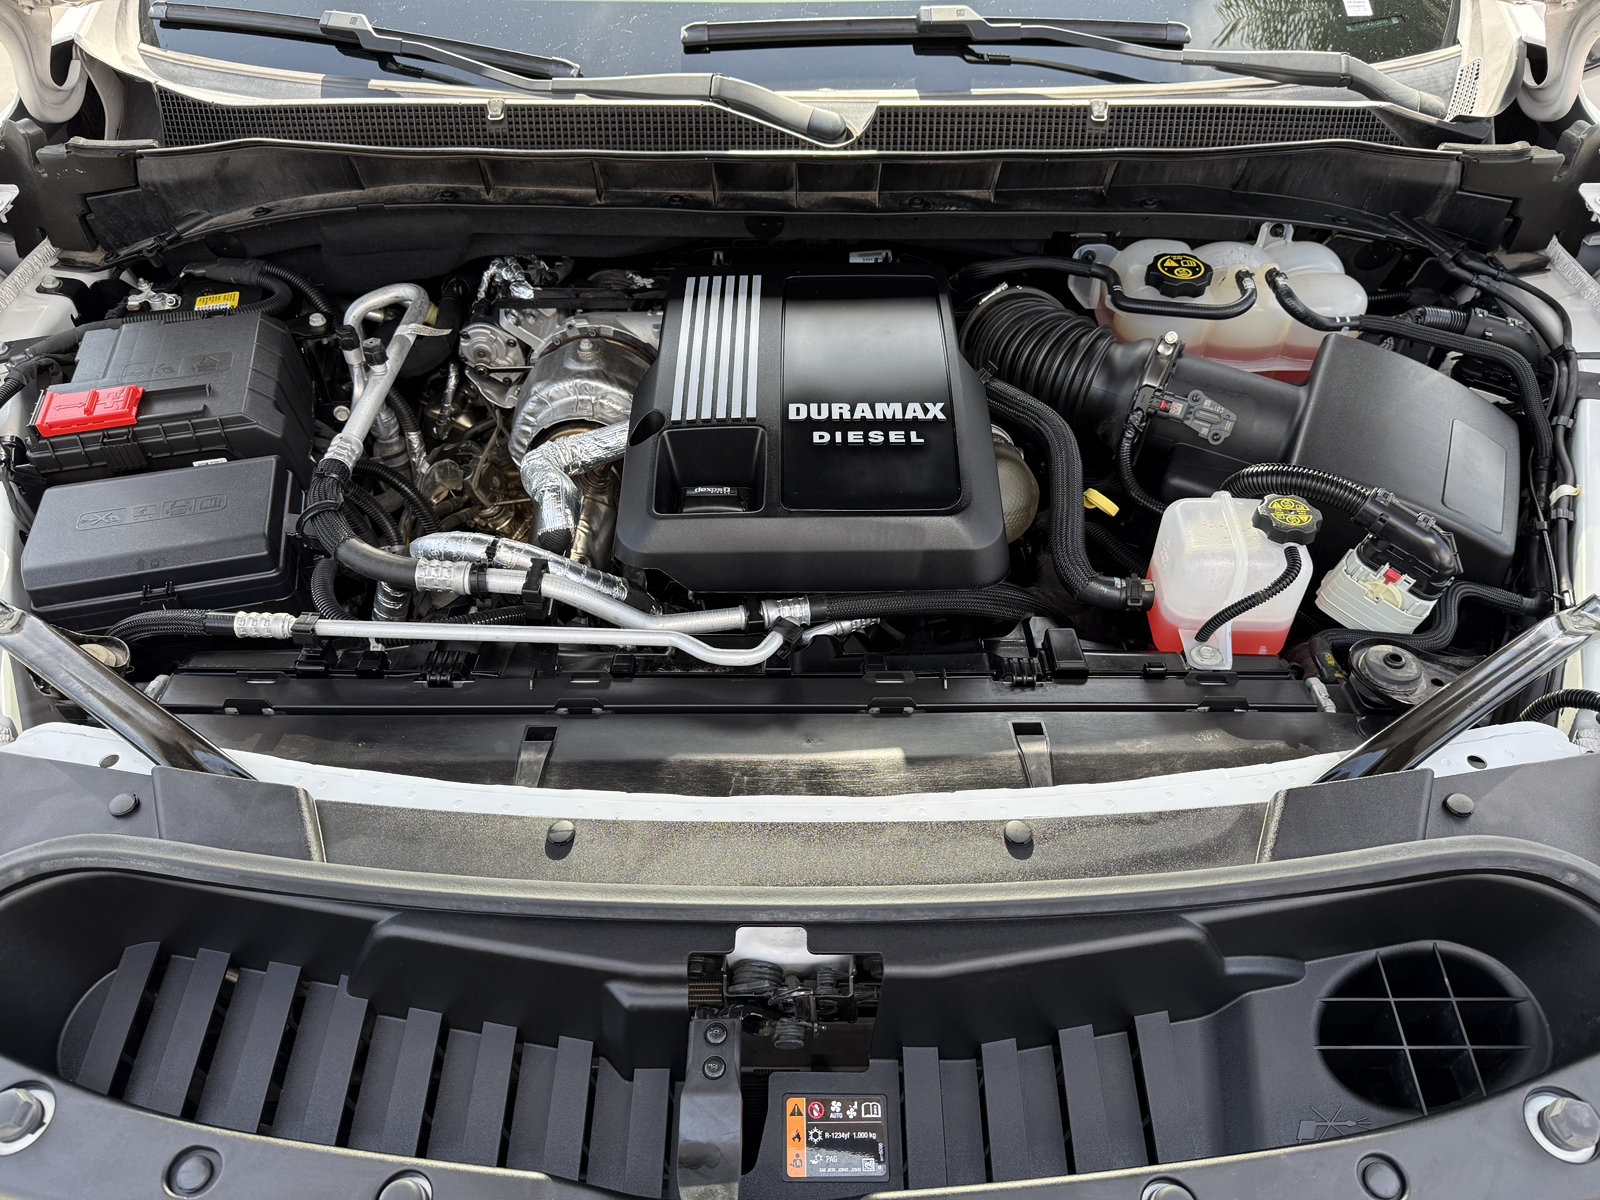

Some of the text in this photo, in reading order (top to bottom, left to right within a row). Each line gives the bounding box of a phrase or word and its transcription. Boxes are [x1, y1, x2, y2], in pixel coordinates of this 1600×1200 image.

[788, 402, 947, 421] DURAMAX
[812, 430, 925, 445] DIESEL
[824, 1131, 877, 1140] R-1234yf 1.000 kg
[825, 1155, 838, 1163] PAG
